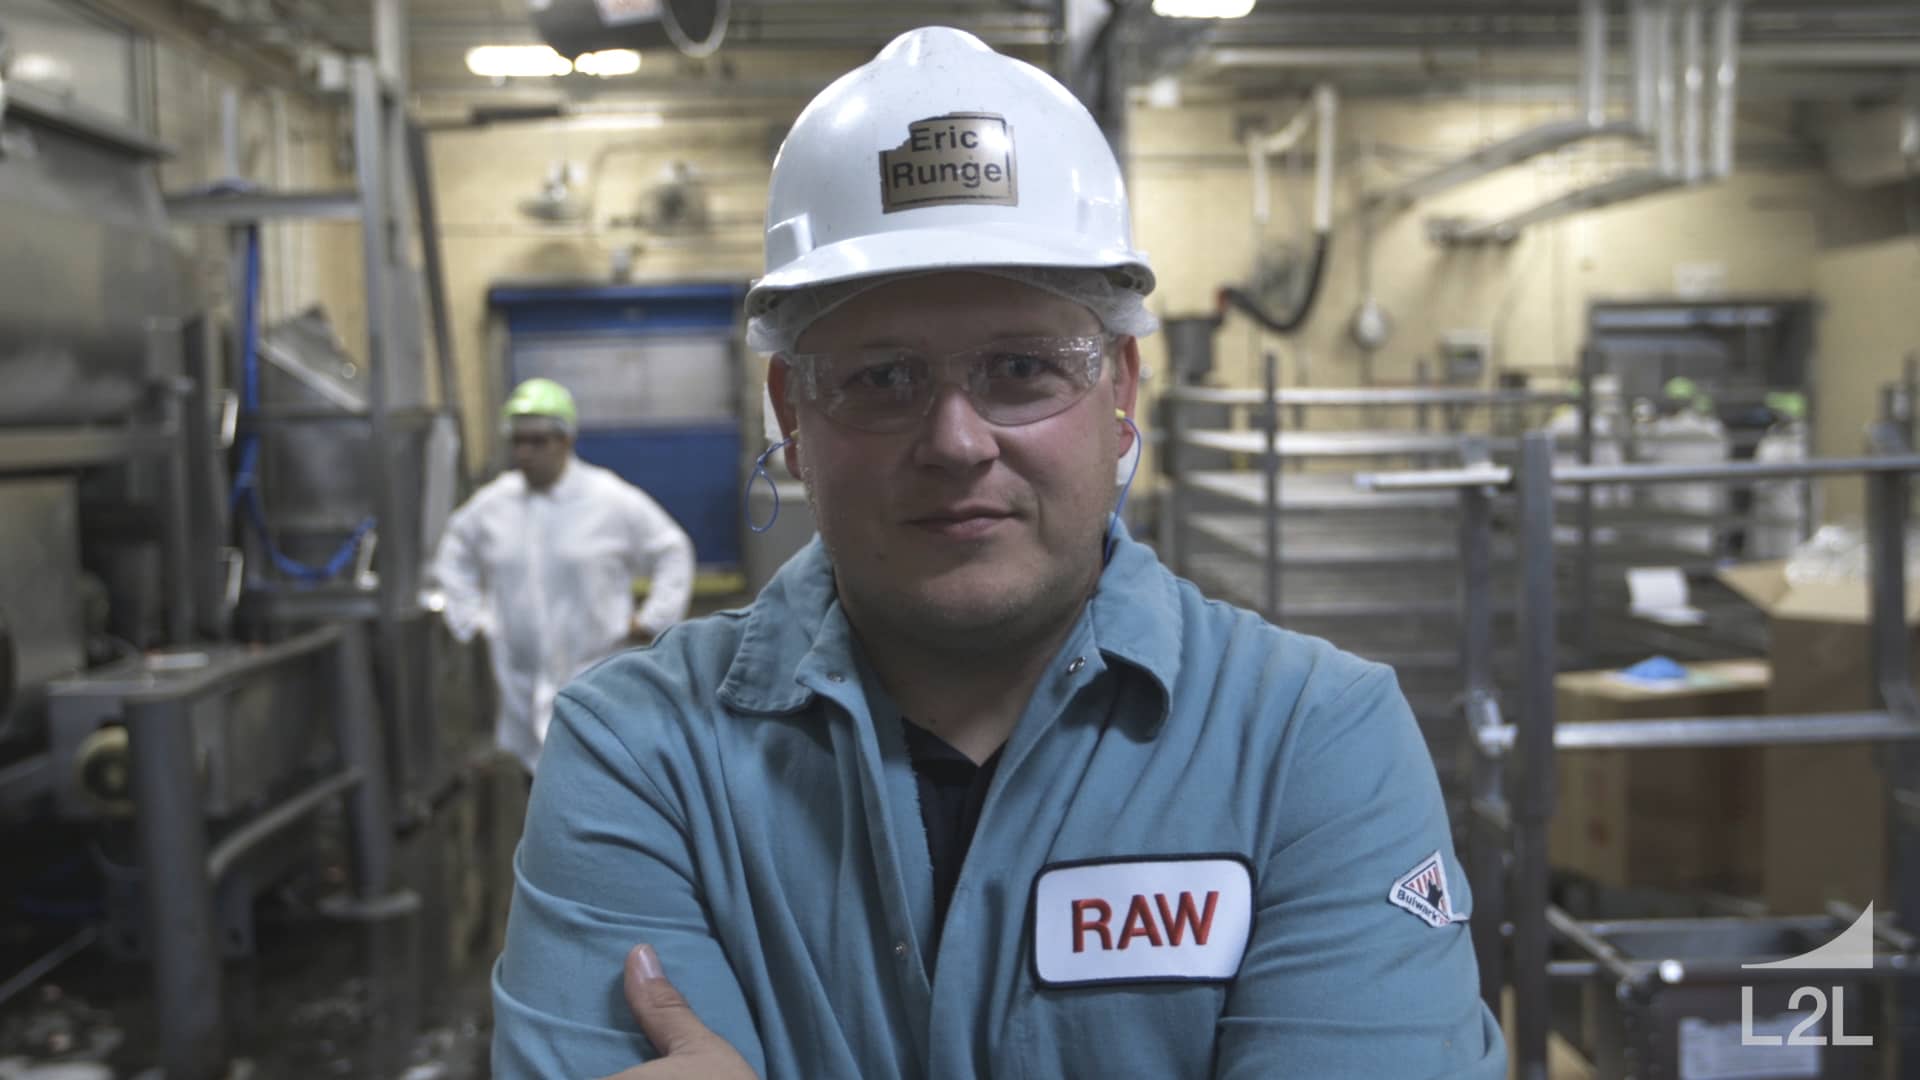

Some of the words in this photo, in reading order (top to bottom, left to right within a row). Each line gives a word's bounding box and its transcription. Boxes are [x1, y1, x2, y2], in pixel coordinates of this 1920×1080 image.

[910, 125, 978, 152] Eric
[892, 161, 1002, 189] Runge
[1396, 889, 1438, 922] Bulwark
[1071, 891, 1219, 953] RAW
